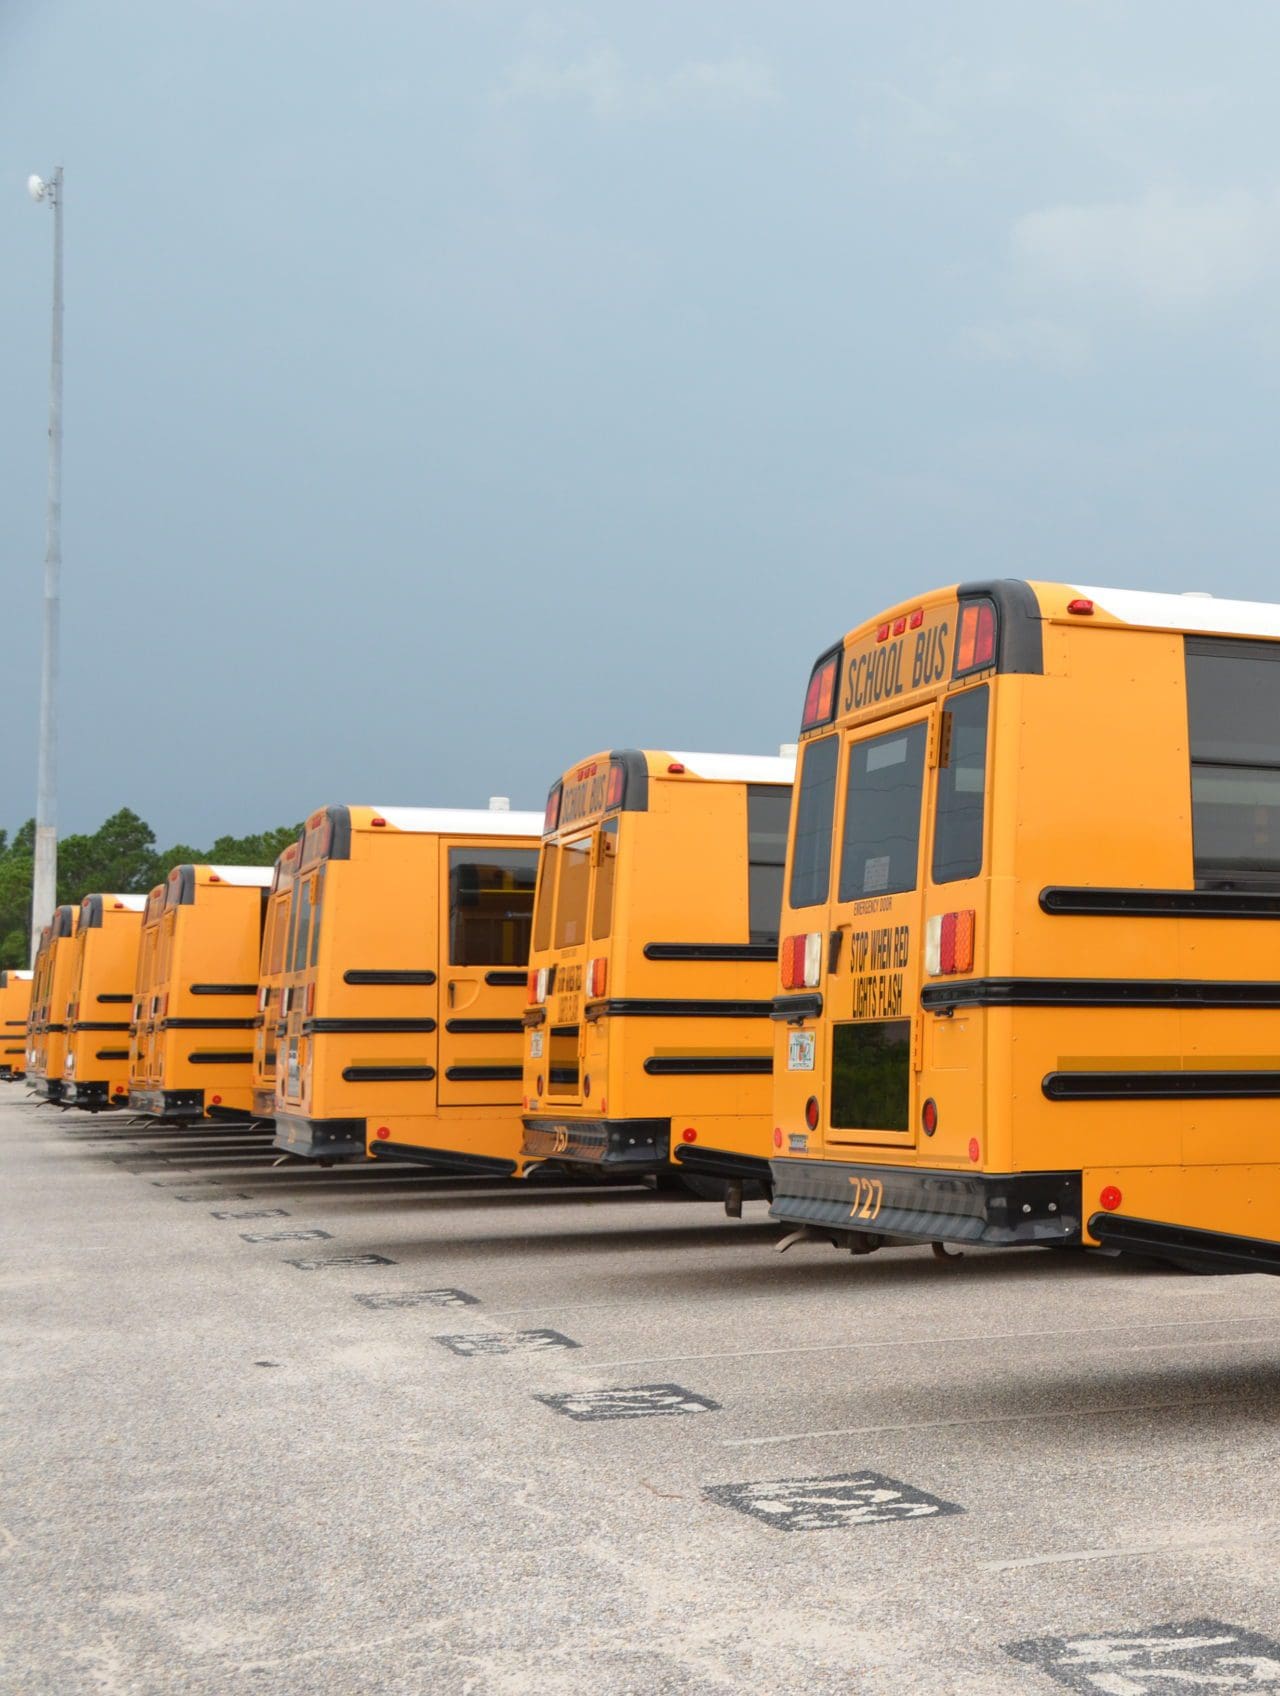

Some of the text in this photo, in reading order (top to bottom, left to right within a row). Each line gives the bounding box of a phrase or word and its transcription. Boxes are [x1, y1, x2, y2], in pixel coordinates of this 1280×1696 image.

[845, 622, 949, 712] SCHOOL BUS
[851, 926, 909, 973] STOP WHEN RED
[853, 973, 903, 1018] LIGHTS FLASH
[848, 1176, 883, 1219] 727
